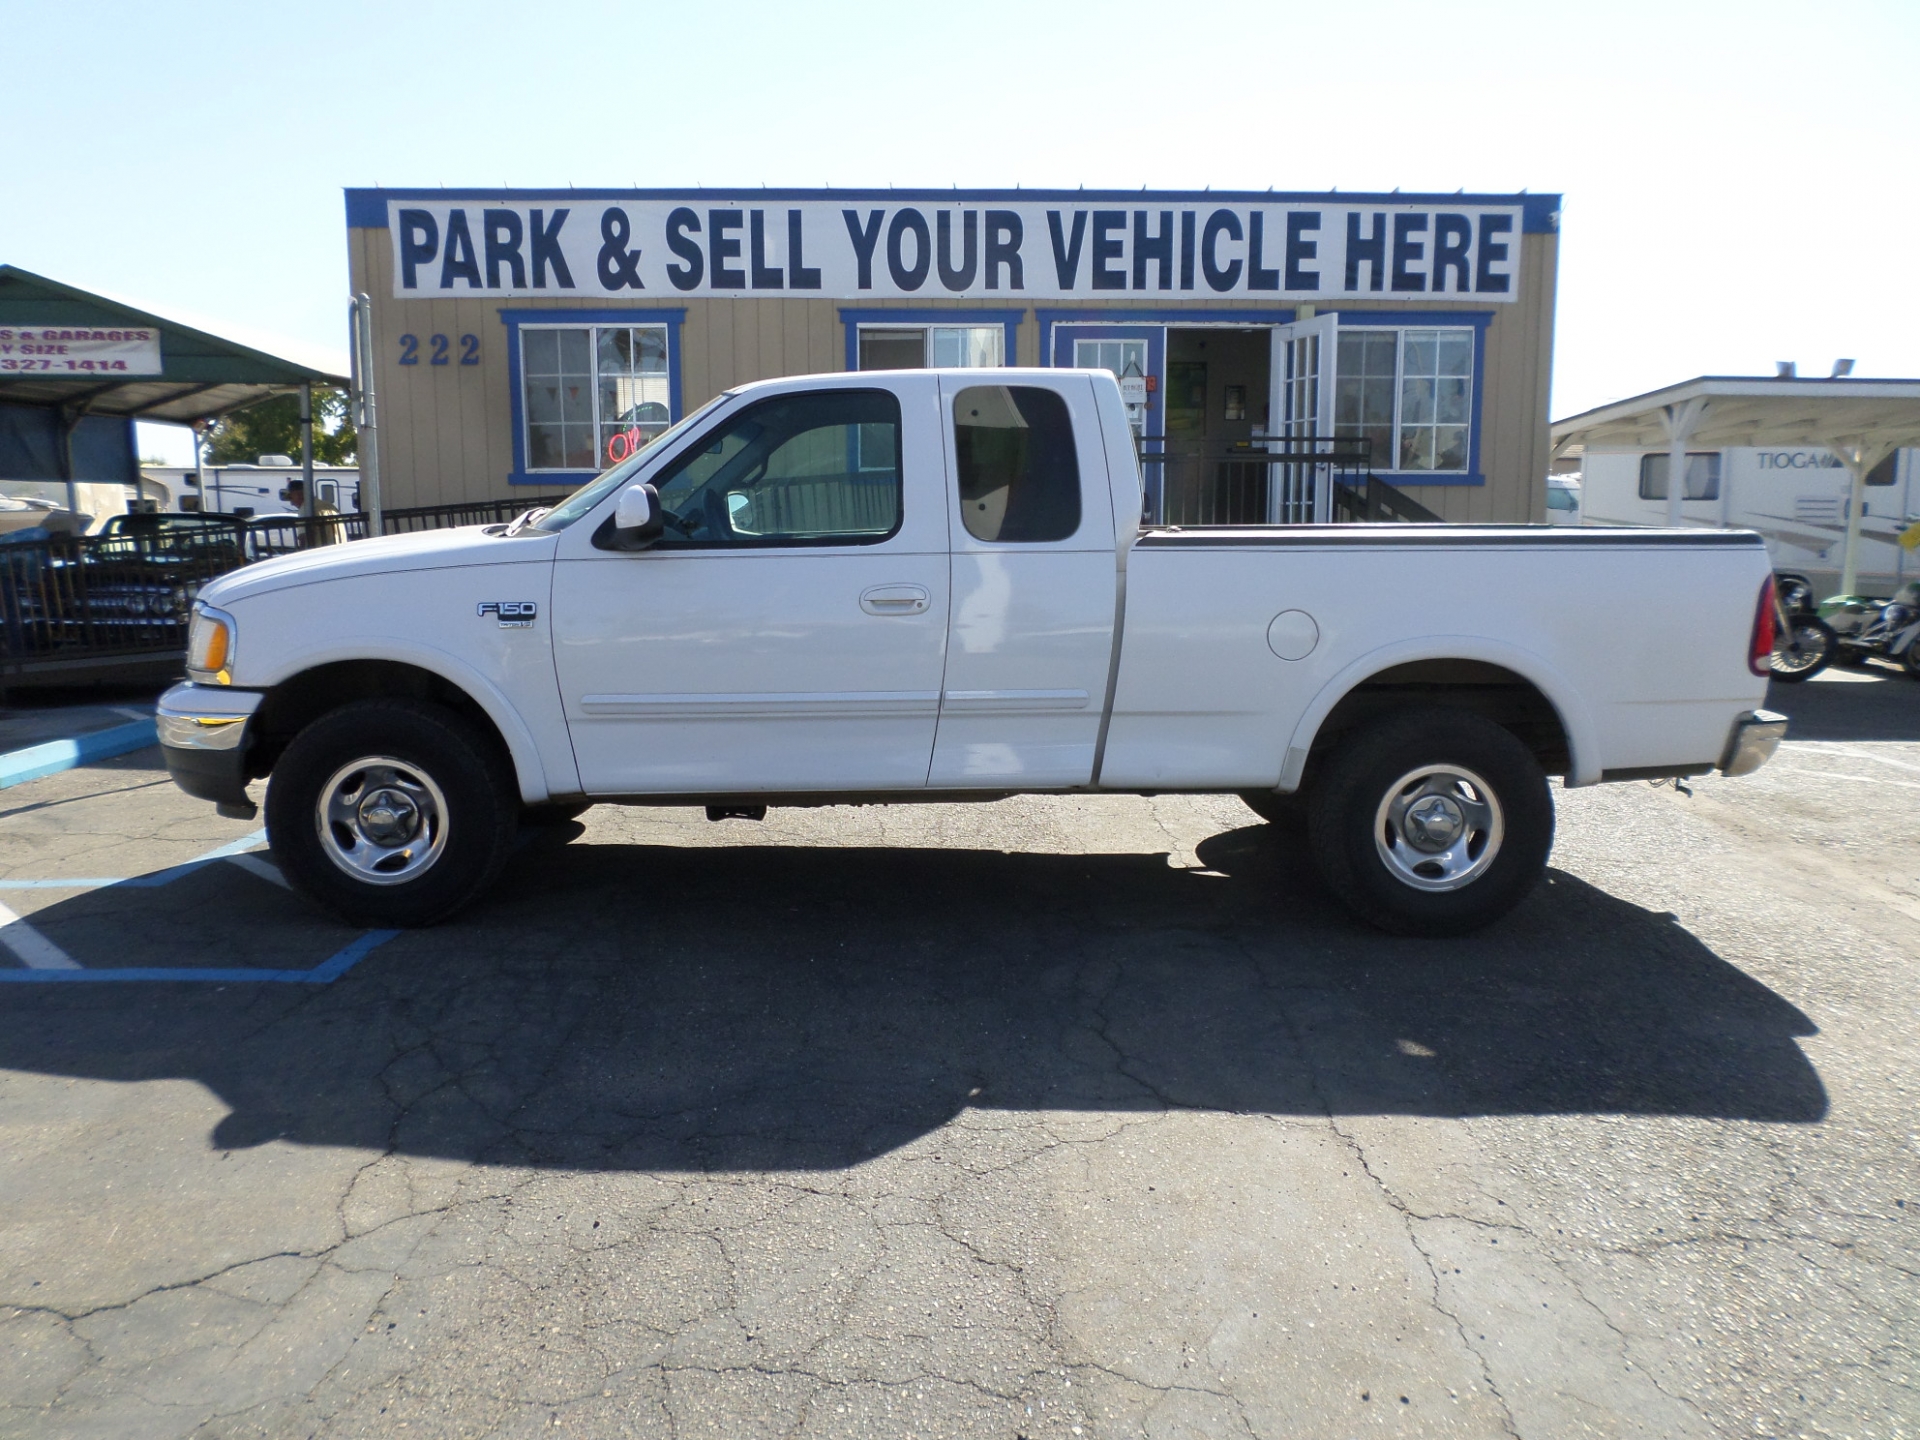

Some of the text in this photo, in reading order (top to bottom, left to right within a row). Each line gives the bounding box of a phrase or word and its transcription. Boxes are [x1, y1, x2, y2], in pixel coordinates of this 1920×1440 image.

[398, 206, 1514, 293] PARK & SELL YOUR VEHICLE HERE
[19, 331, 35, 341] &
[42, 330, 150, 342] GARAGES
[20, 344, 69, 356] SIZE
[398, 333, 480, 366] 222
[0, 359, 128, 371] 327-1414
[1757, 452, 1819, 469] TIOGA
